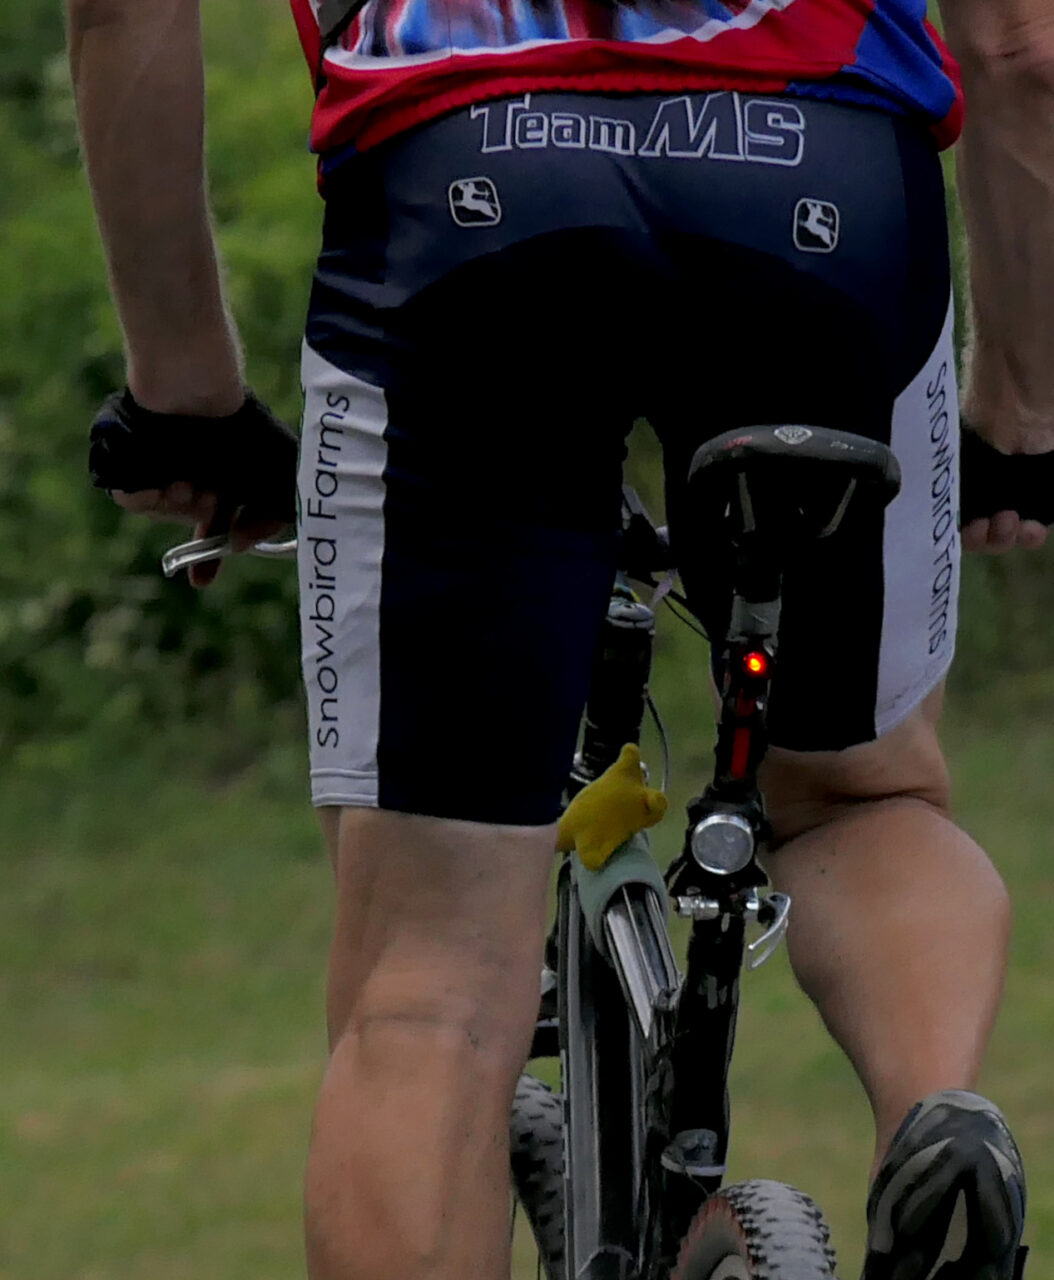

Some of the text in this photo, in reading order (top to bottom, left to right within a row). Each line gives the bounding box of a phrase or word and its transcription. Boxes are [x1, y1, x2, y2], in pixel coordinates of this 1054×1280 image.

[470, 91, 805, 167] Team MS
[307, 392, 351, 749] Snowbird Farms
